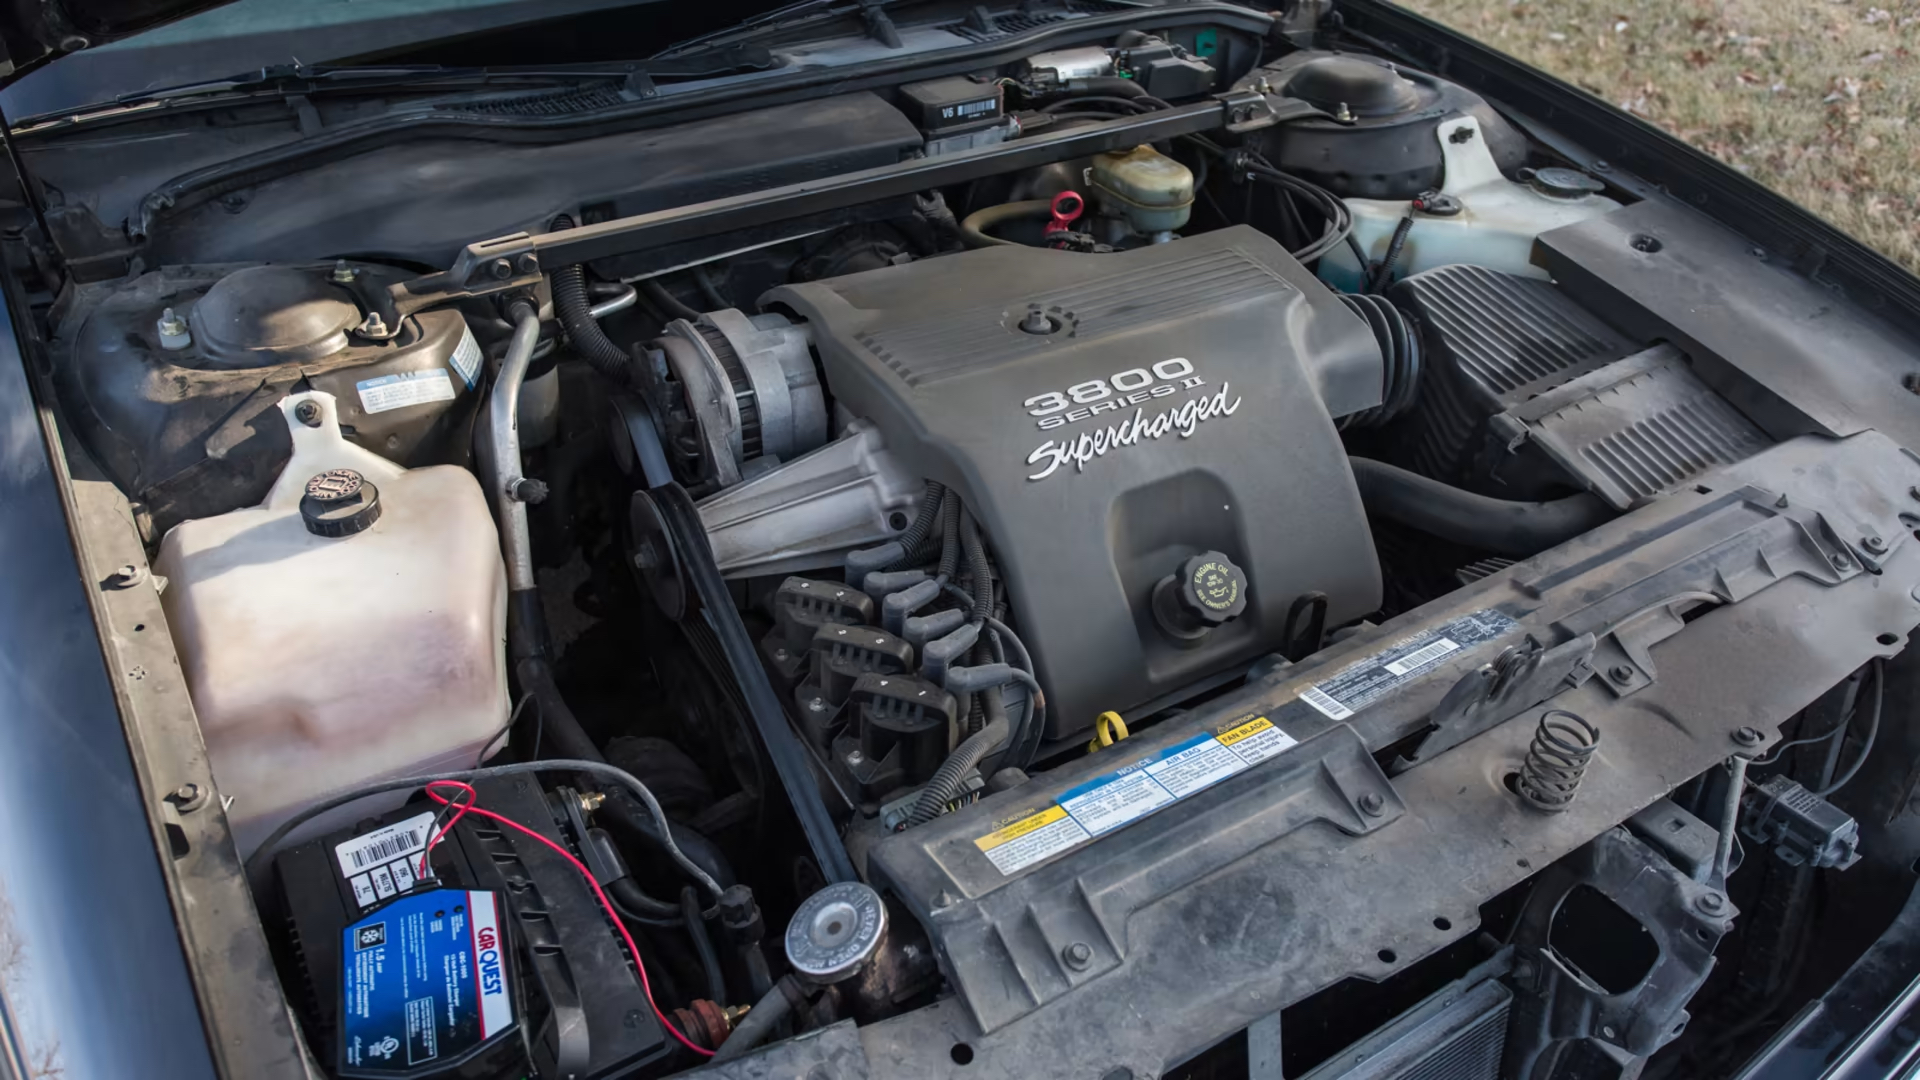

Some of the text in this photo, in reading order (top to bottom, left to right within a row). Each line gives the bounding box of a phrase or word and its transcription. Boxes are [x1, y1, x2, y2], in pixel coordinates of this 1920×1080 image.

[942, 107, 954, 118] V6
[1024, 357, 1194, 416] 3800
[1037, 375, 1206, 430] SERIES II
[1027, 382, 1242, 480] Supercharged
[1194, 562, 1229, 584] ENGINE OIL
[1222, 720, 1268, 743] FAN BLADE
[1116, 758, 1154, 776] NOTICE
[1165, 747, 1201, 766] AIR BAG
[1001, 807, 1036, 824] CAUTION
[375, 947, 385, 961] 1.5
[477, 926, 502, 995] CARQUEST
[828, 943, 861, 967] OPEN
